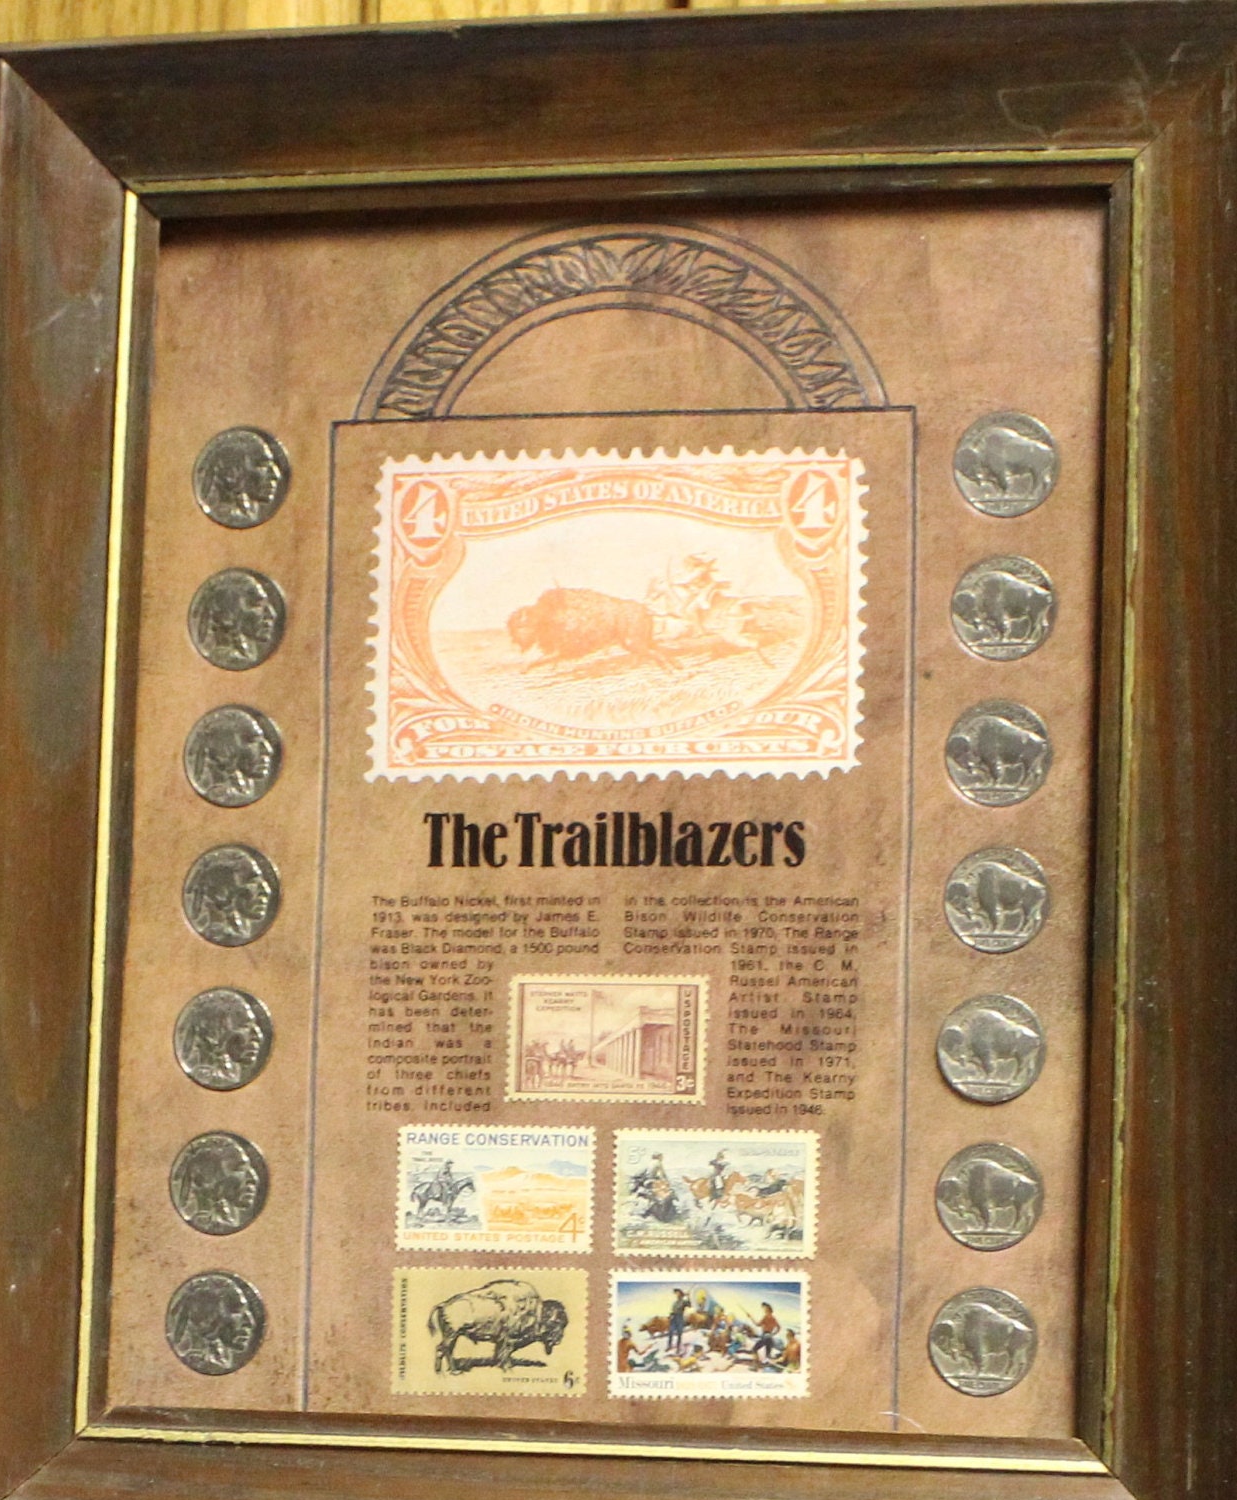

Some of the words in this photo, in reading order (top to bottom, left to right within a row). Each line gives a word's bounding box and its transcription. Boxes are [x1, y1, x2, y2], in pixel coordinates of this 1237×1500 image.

[462, 498, 540, 526] UNITED
[544, 481, 628, 510] STATES
[633, 482, 664, 500] OF
[666, 485, 781, 517] AMERICA
[791, 472, 835, 528] 4
[403, 484, 446, 538] 4
[409, 717, 491, 739] FOUR
[736, 711, 822, 732] FOUR
[566, 727, 645, 741] HUNTING
[424, 744, 586, 758] POSTAGE
[595, 743, 692, 757] FOUR
[695, 741, 810, 755] CENTS
[424, 812, 508, 867] The
[514, 811, 806, 867] Trailblazers
[372, 896, 396, 907] The
[401, 896, 450, 907] Buffalo
[505, 896, 531, 906] first
[536, 896, 583, 906] minted
[588, 896, 601, 905] in
[412, 913, 438, 922] was
[445, 911, 506, 924] designed
[513, 912, 529, 925] by
[536, 912, 580, 922] James
[624, 911, 666, 922] Bison
[684, 911, 742, 922] Wildlife
[759, 911, 859, 922] Conservation
[370, 945, 396, 954] was
[401, 943, 436, 954] Black
[510, 945, 518, 954] a
[524, 943, 552, 954] 1500
[557, 943, 599, 956] pound
[370, 959, 410, 970] bison
[420, 959, 467, 969] owned
[477, 959, 493, 971] by
[726, 1072, 754, 1083] and
[764, 1072, 792, 1083] The
[803, 1072, 856, 1085] Kearny
[726, 1088, 802, 1100] Expedition
[810, 1088, 855, 1100] Stamp
[406, 1133, 459, 1145] RANGE
[465, 1133, 589, 1147] CONSERVATION
[404, 1232, 448, 1241] UNITED
[454, 1232, 500, 1242] STATES
[506, 1233, 565, 1243] POSTAGE
[618, 1375, 674, 1390] Missouri
